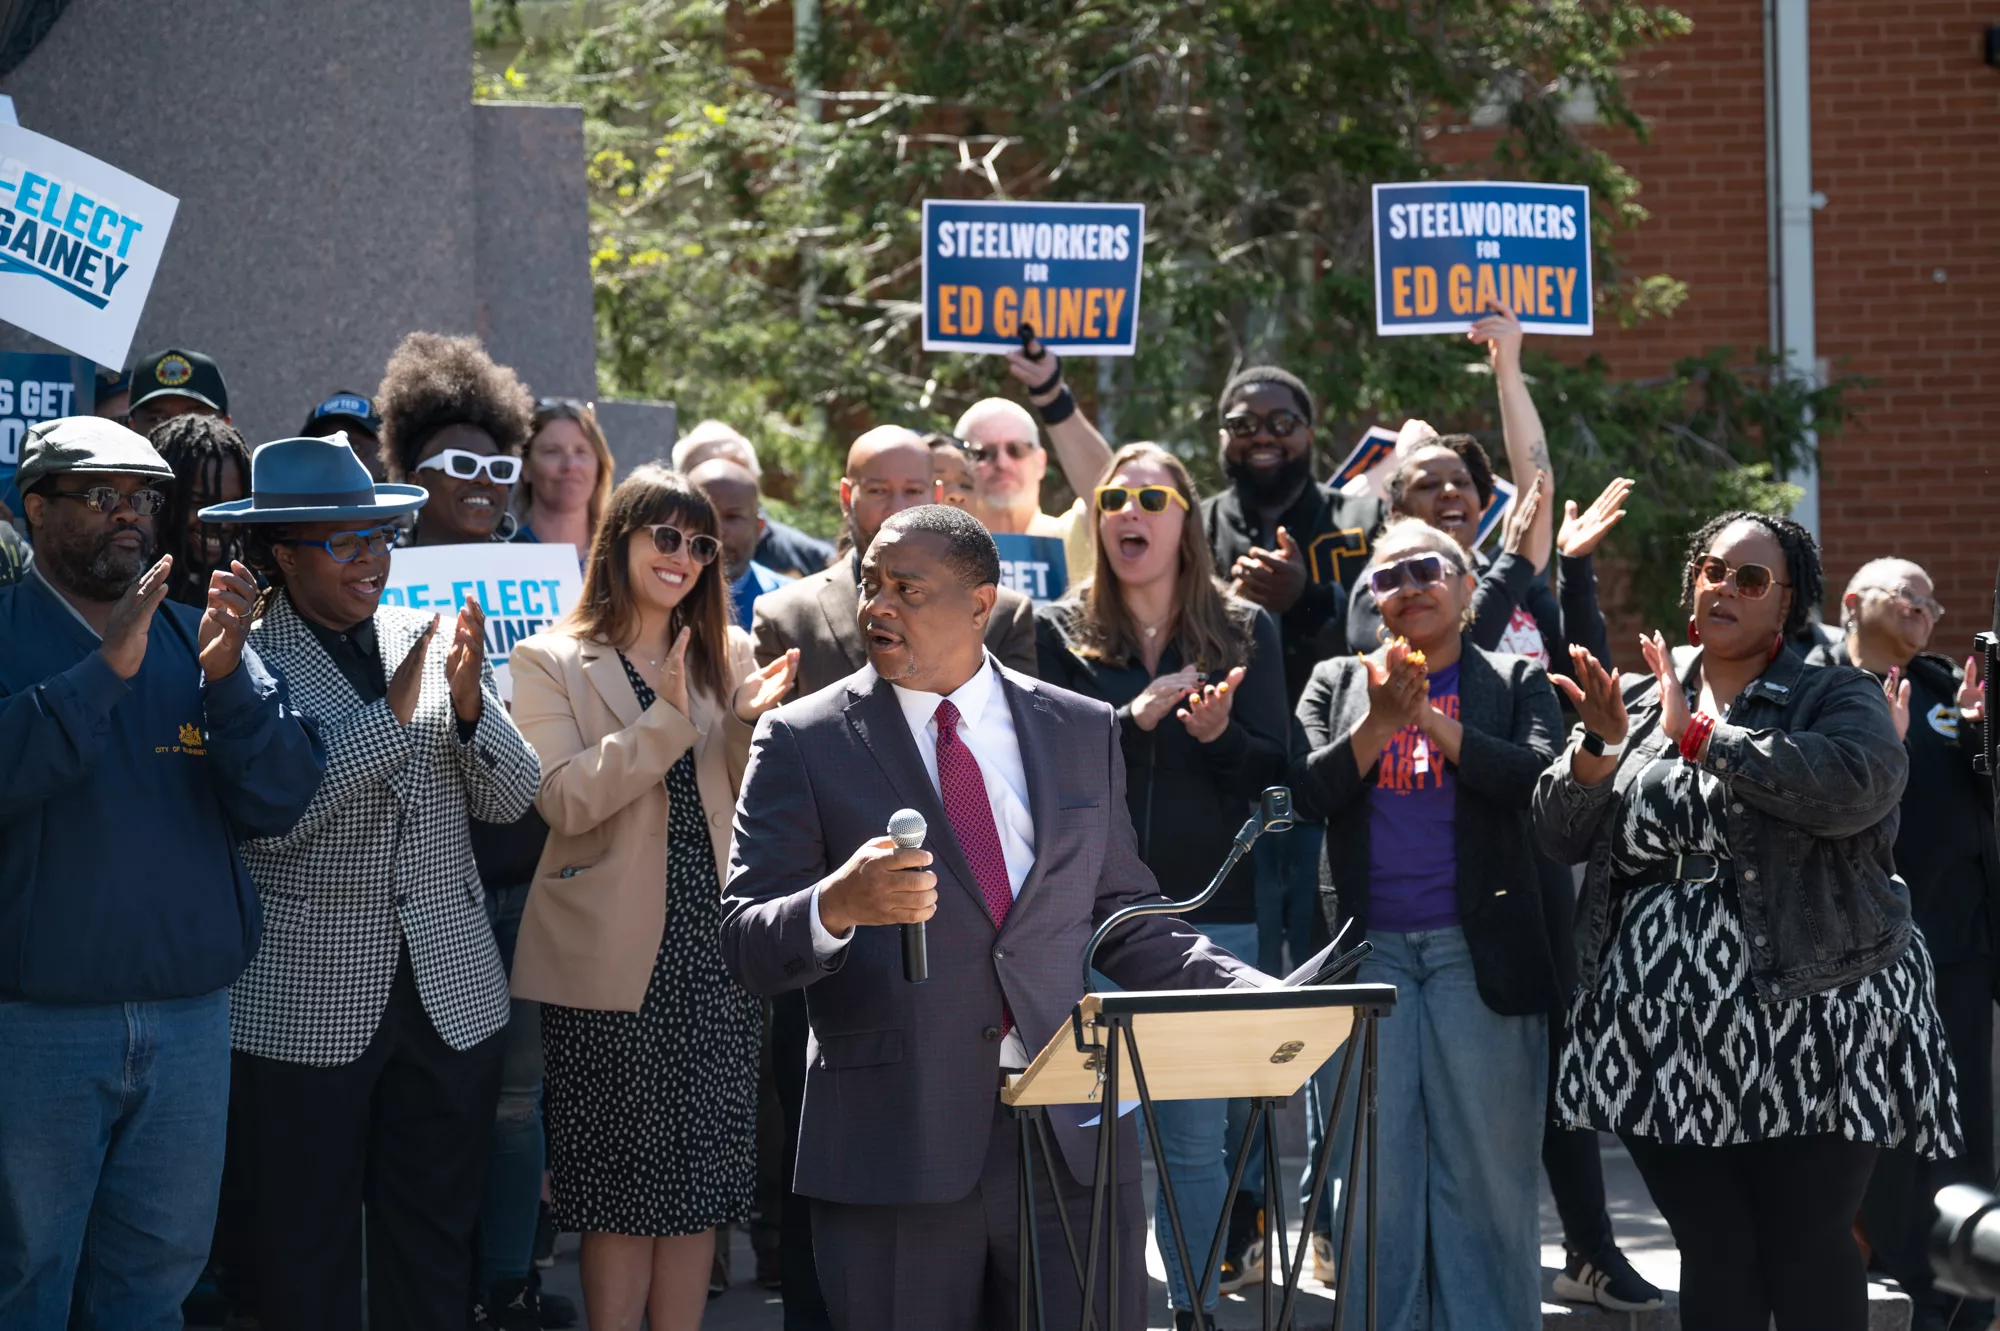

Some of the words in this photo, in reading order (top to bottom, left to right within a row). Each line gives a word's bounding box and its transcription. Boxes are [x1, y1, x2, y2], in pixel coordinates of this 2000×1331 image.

[1389, 201, 1577, 240] STEELWORKERS
[937, 220, 1130, 261] STEELWORKERS
[1476, 240, 1501, 259] FOR
[1024, 263, 1049, 282] FOR
[1392, 265, 1438, 317] ED
[1448, 263, 1578, 317] GAINEY
[938, 284, 983, 335] ED
[993, 285, 1126, 338] GAINEY
[20, 379, 75, 417] GET
